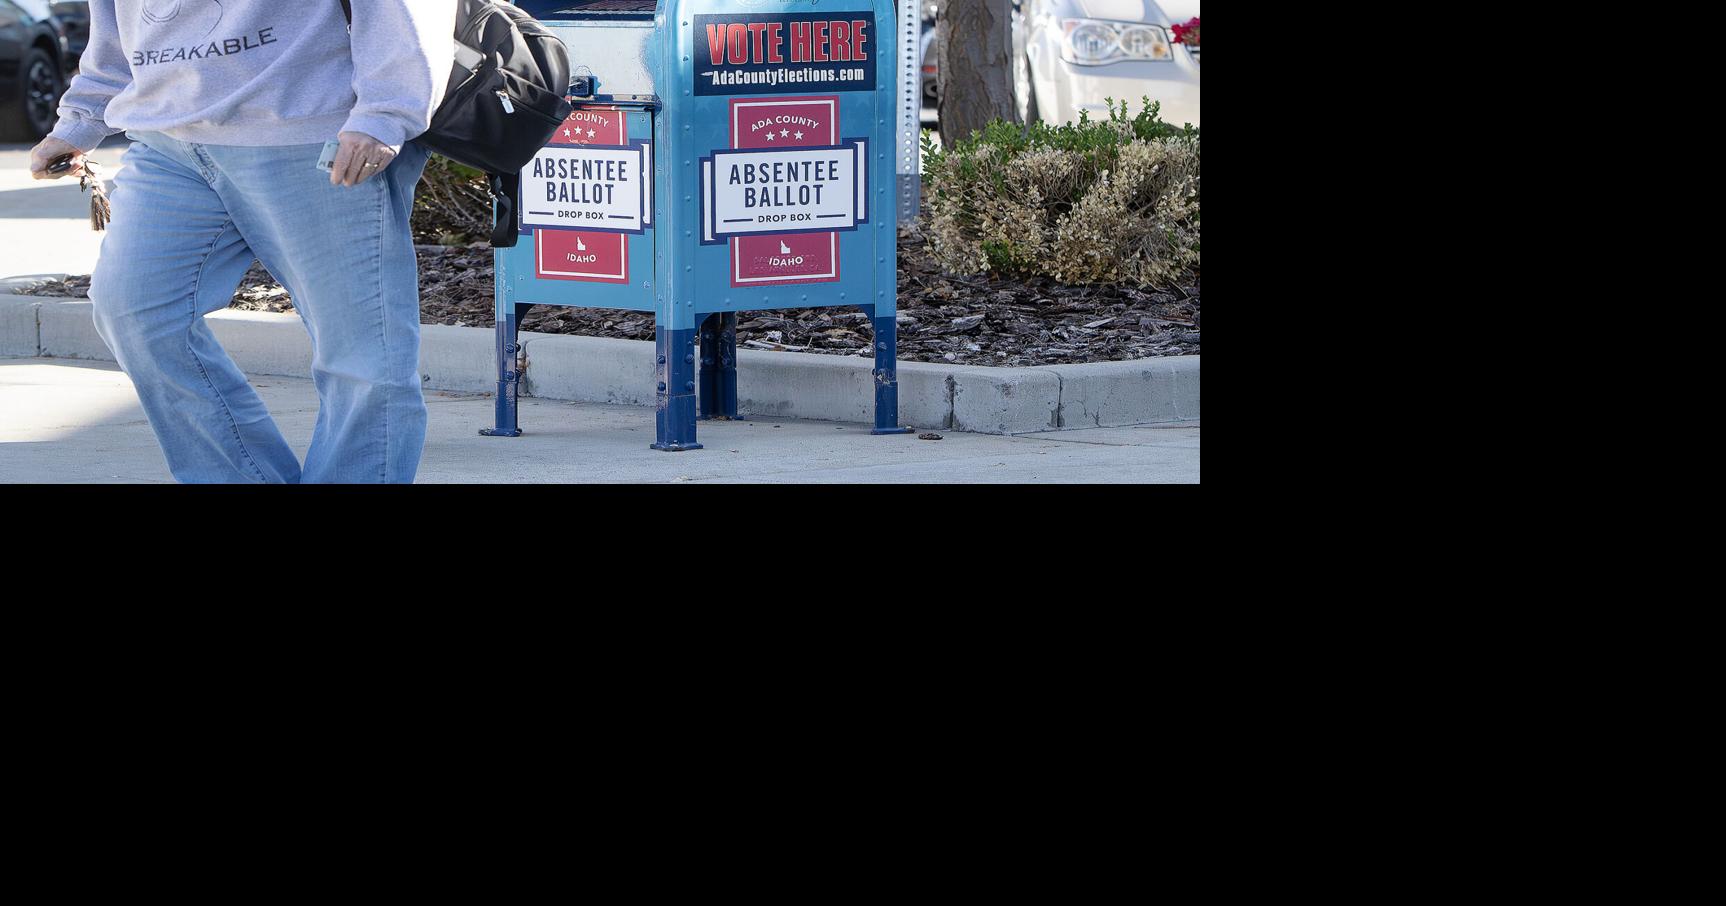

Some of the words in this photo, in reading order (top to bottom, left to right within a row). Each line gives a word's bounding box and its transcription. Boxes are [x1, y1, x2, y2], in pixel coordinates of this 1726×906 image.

[132, 27, 277, 66] BREAKABLE
[706, 22, 783, 65] VOTE
[790, 20, 867, 62] HERE
[711, 68, 865, 86] AdaCountyElections.com
[570, 112, 609, 128] COUNTY
[751, 117, 774, 132] ADA
[775, 115, 820, 130] COUNTY
[533, 157, 628, 182] ABSENTEE
[729, 160, 839, 185] ABSENTEE
[546, 181, 615, 205] BALLOT
[744, 184, 824, 208] BALLOT
[558, 210, 583, 219] DROP
[585, 211, 604, 220] BOX
[758, 214, 787, 223] DROP
[790, 213, 812, 222] BOX
[566, 252, 597, 263] IDAHO
[768, 256, 803, 267] IDAHO
